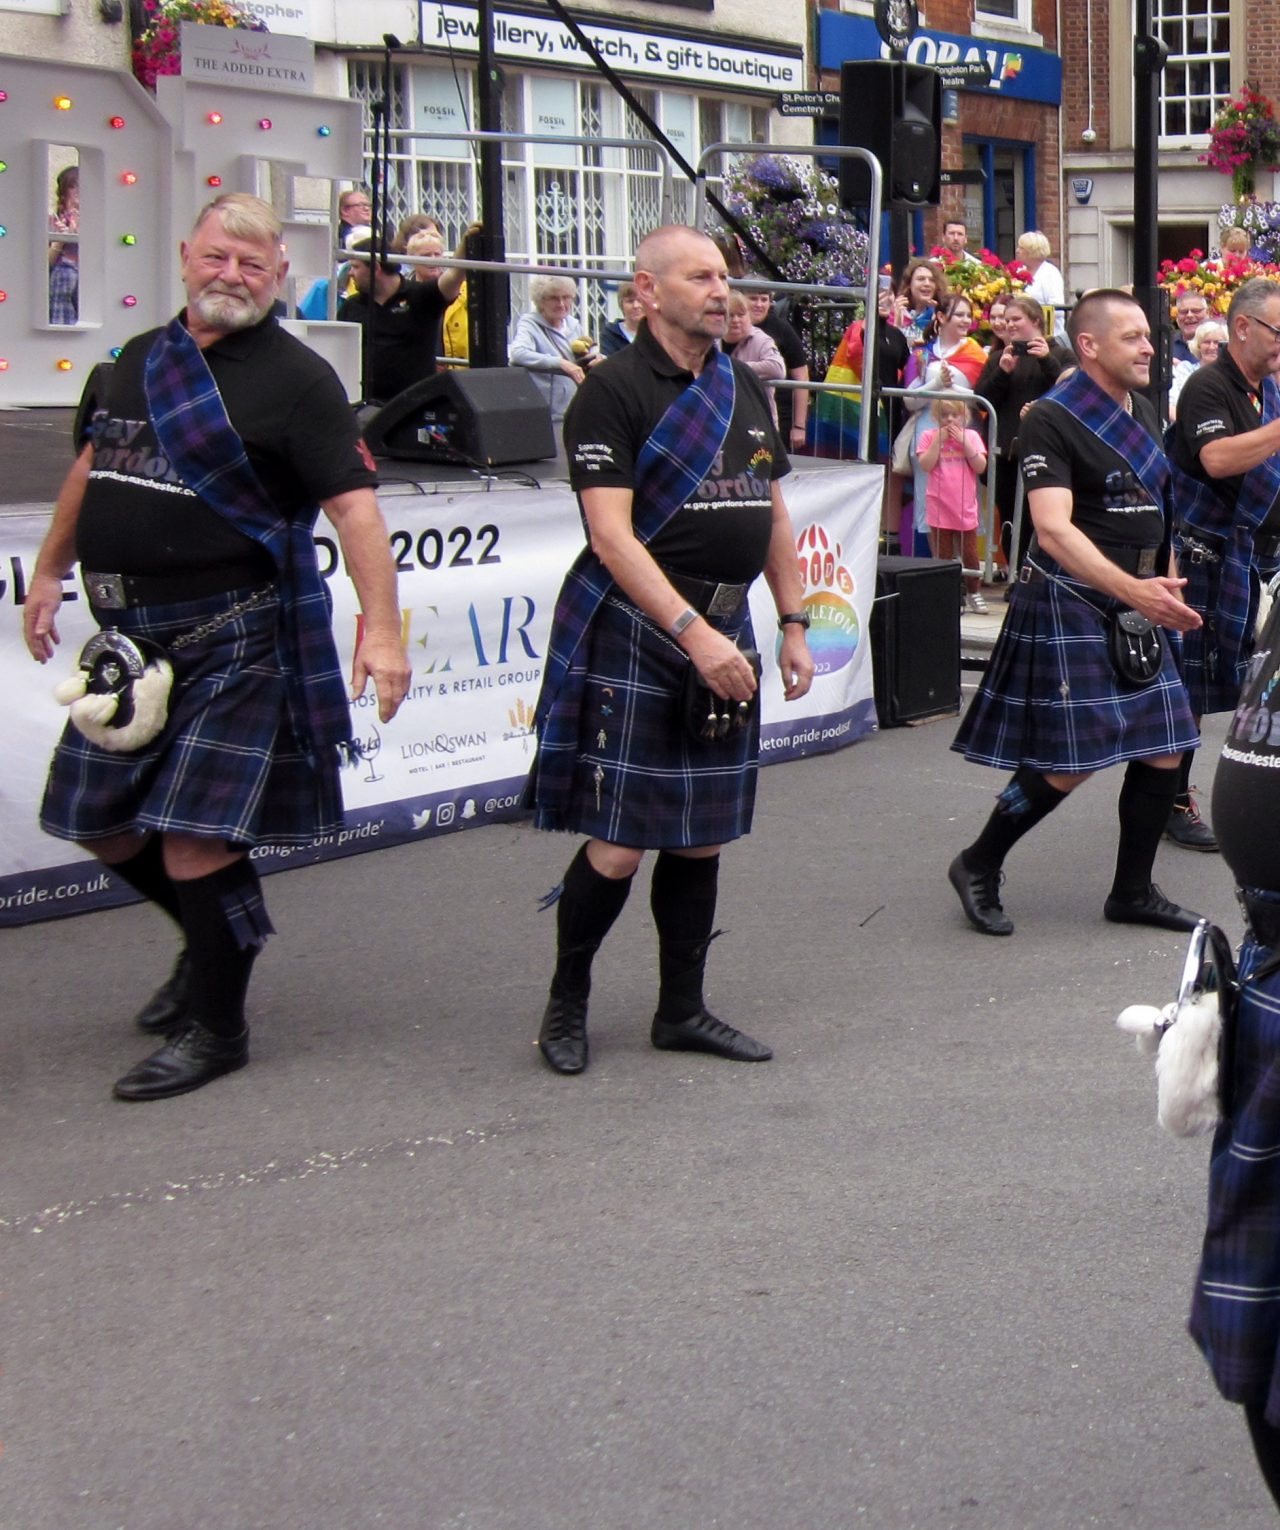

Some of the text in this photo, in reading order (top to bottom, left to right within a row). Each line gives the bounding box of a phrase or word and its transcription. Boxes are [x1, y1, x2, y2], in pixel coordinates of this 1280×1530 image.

[437, 11, 793, 83] jewllery, wtch, & gift boutique
[194, 57, 218, 71] THE
[222, 62, 264, 76] ADDED
[267, 67, 306, 82] EXTRA
[969, 64, 985, 73] Park
[424, 106, 456, 117] FOSSIL
[782, 104, 825, 115] Cemetery
[539, 115, 566, 126] FOSSIL
[390, 524, 501, 573] 2022
[438, 684, 448, 695] &
[453, 677, 492, 693] RETAIL
[498, 669, 541, 686] GROUP
[759, 738, 790, 753] leton
[792, 729, 820, 748] pride
[409, 766, 428, 774] HOTEL
